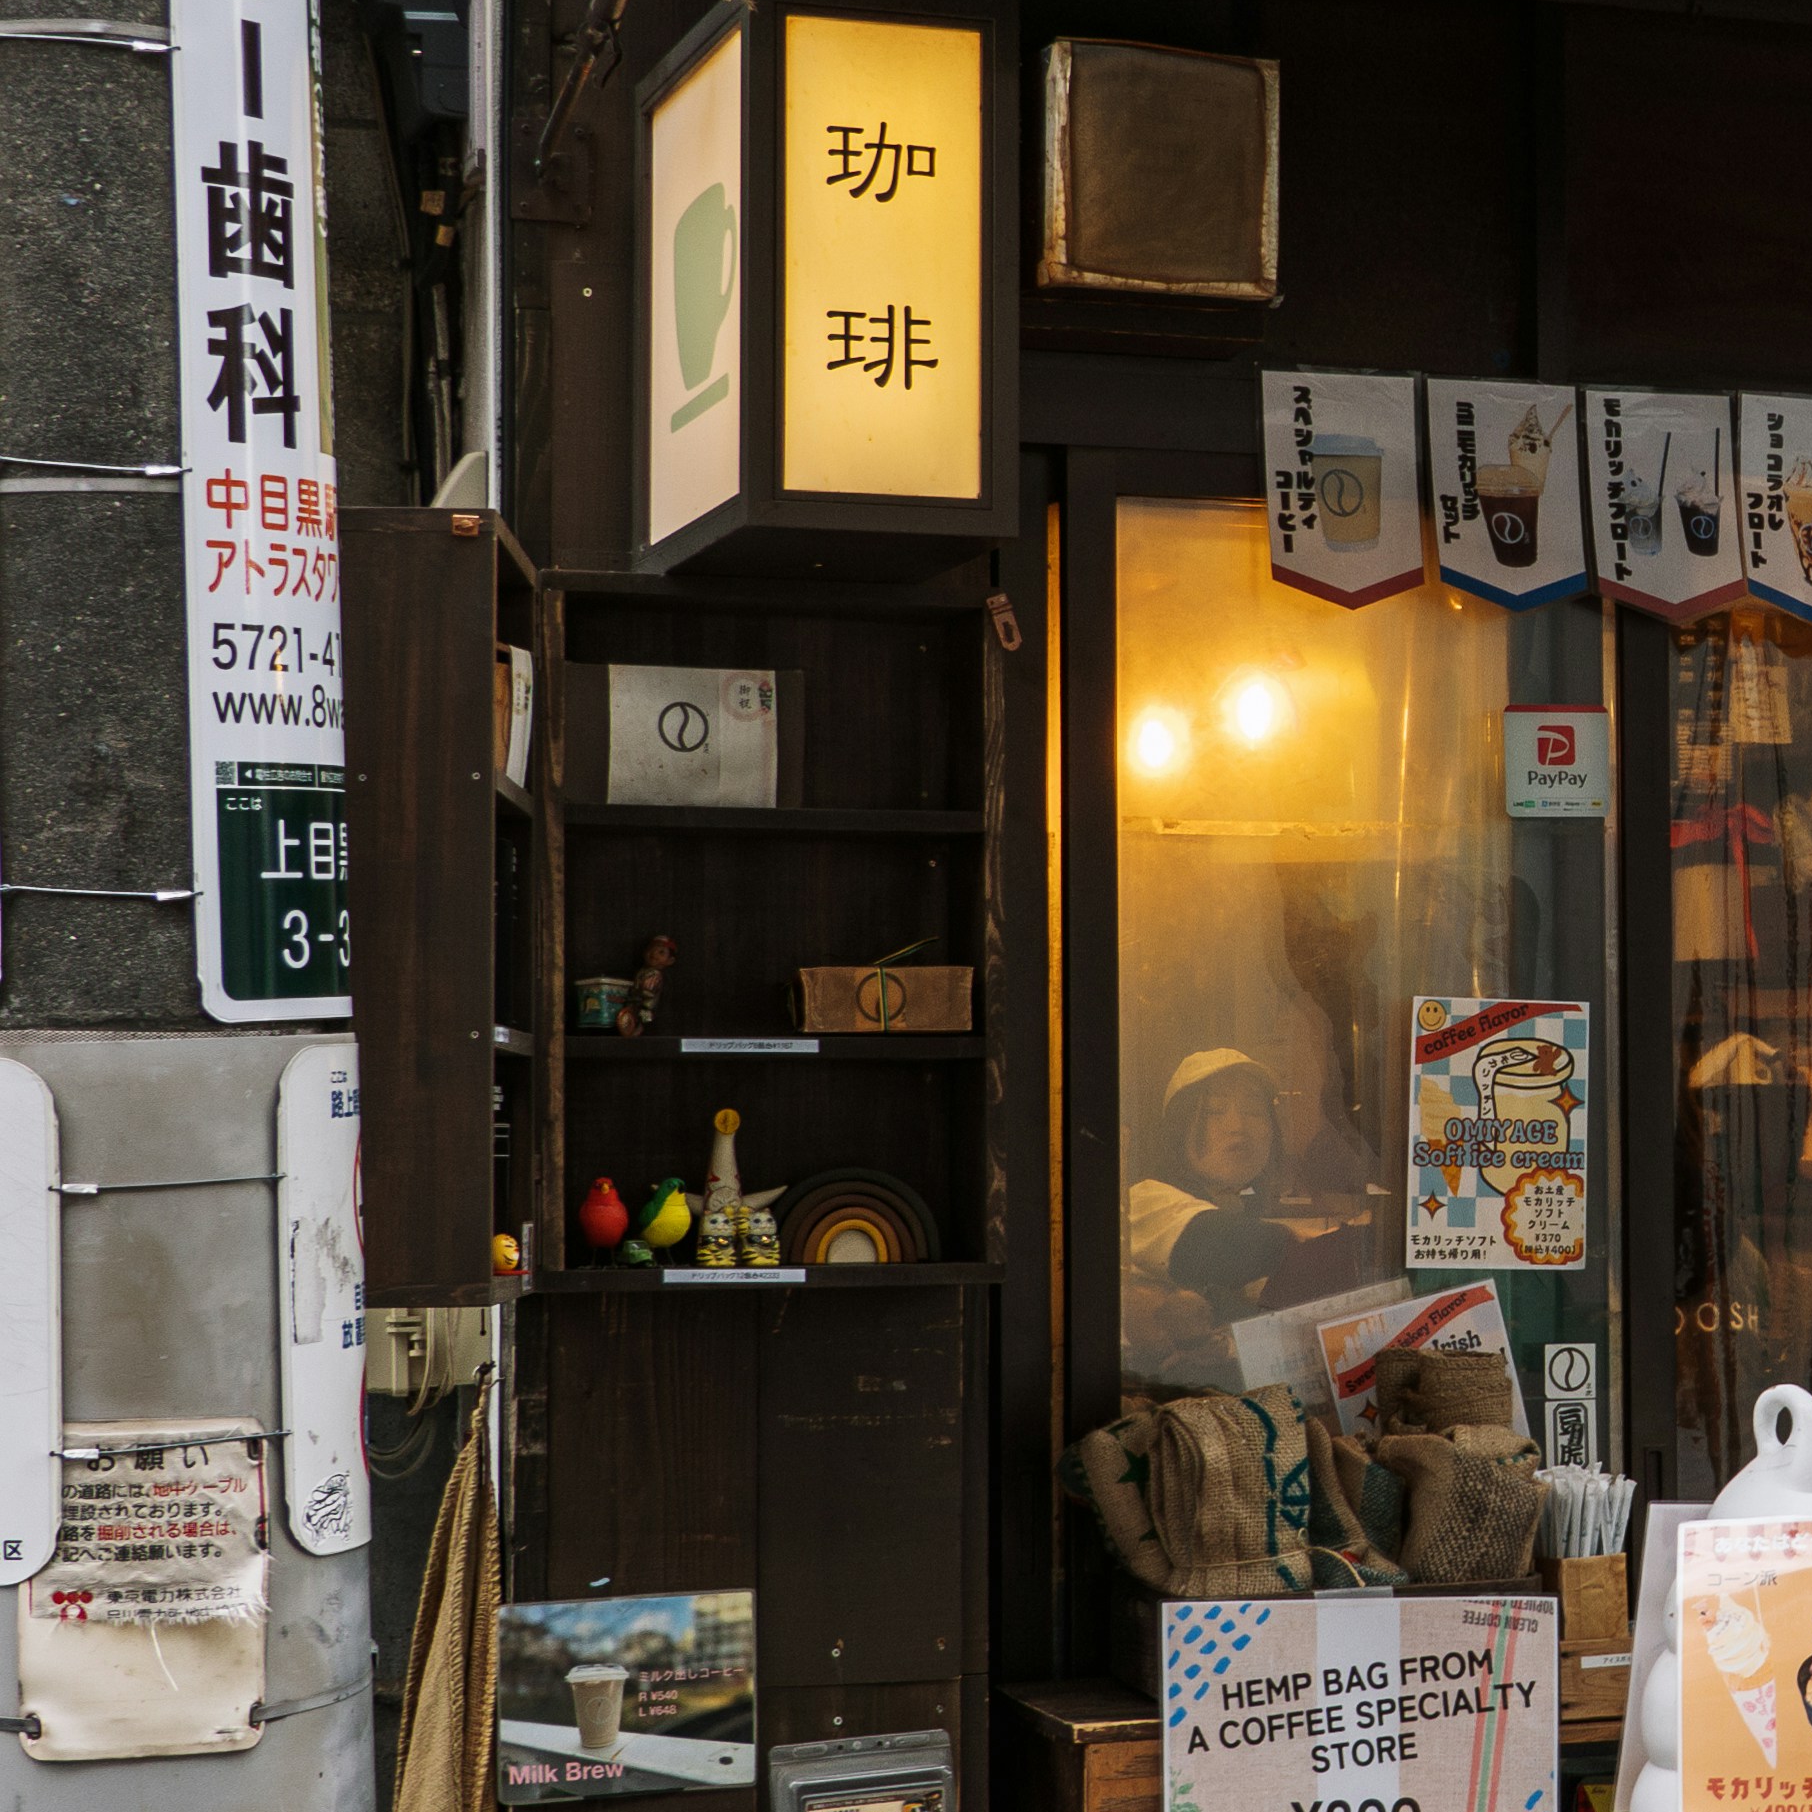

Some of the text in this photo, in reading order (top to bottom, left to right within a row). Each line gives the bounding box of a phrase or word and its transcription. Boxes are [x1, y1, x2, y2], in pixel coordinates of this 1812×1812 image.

[826, 122, 939, 391] 珈琲
[1294, 385, 1318, 529] スペシャルティ
[1767, 413, 1785, 531] ショコラオレ
[1603, 398, 1633, 581] モカリッチフロート
[1275, 470, 1297, 554] コーヒー
[1440, 494, 1461, 545] セット
[1746, 492, 1768, 569] フロート
[1527, 770, 1588, 788] PayPay
[1422, 1003, 1530, 1055] coffee flavor
[1443, 1117, 1559, 1146] OMIYAGE
[1412, 1140, 1586, 1170] Soft ice cream
[1522, 1196, 1577, 1208] モカリッチ
[1533, 1185, 1566, 1196] お土産
[1526, 1218, 1571, 1231] クリーム
[1533, 1207, 1566, 1219] ソフト
[1410, 1233, 1498, 1247] モカリッチソフト
[1534, 1232, 1562, 1244] ¥370
[1413, 1248, 1489, 1261] お持ち帰り用!
[1428, 1291, 1469, 1325] Flavor
[62, 1501, 224, 1521] 埋設されております。
[5, 1539, 23, 1561] 区
[1706, 1569, 1779, 1587] コーン派
[107, 1585, 243, 1604] 東京電力株式会社
[637, 1664, 746, 1683] ミルク出しコーヒー
[1221, 1647, 1495, 1711] HEMP BAG FROM
[637, 1690, 648, 1702] R
[638, 1706, 647, 1717] L
[1187, 1680, 1538, 1755] A COFFEE SPECIALTY
[1311, 1732, 1419, 1774] STORE
[507, 1760, 625, 1787] Milk Brew
